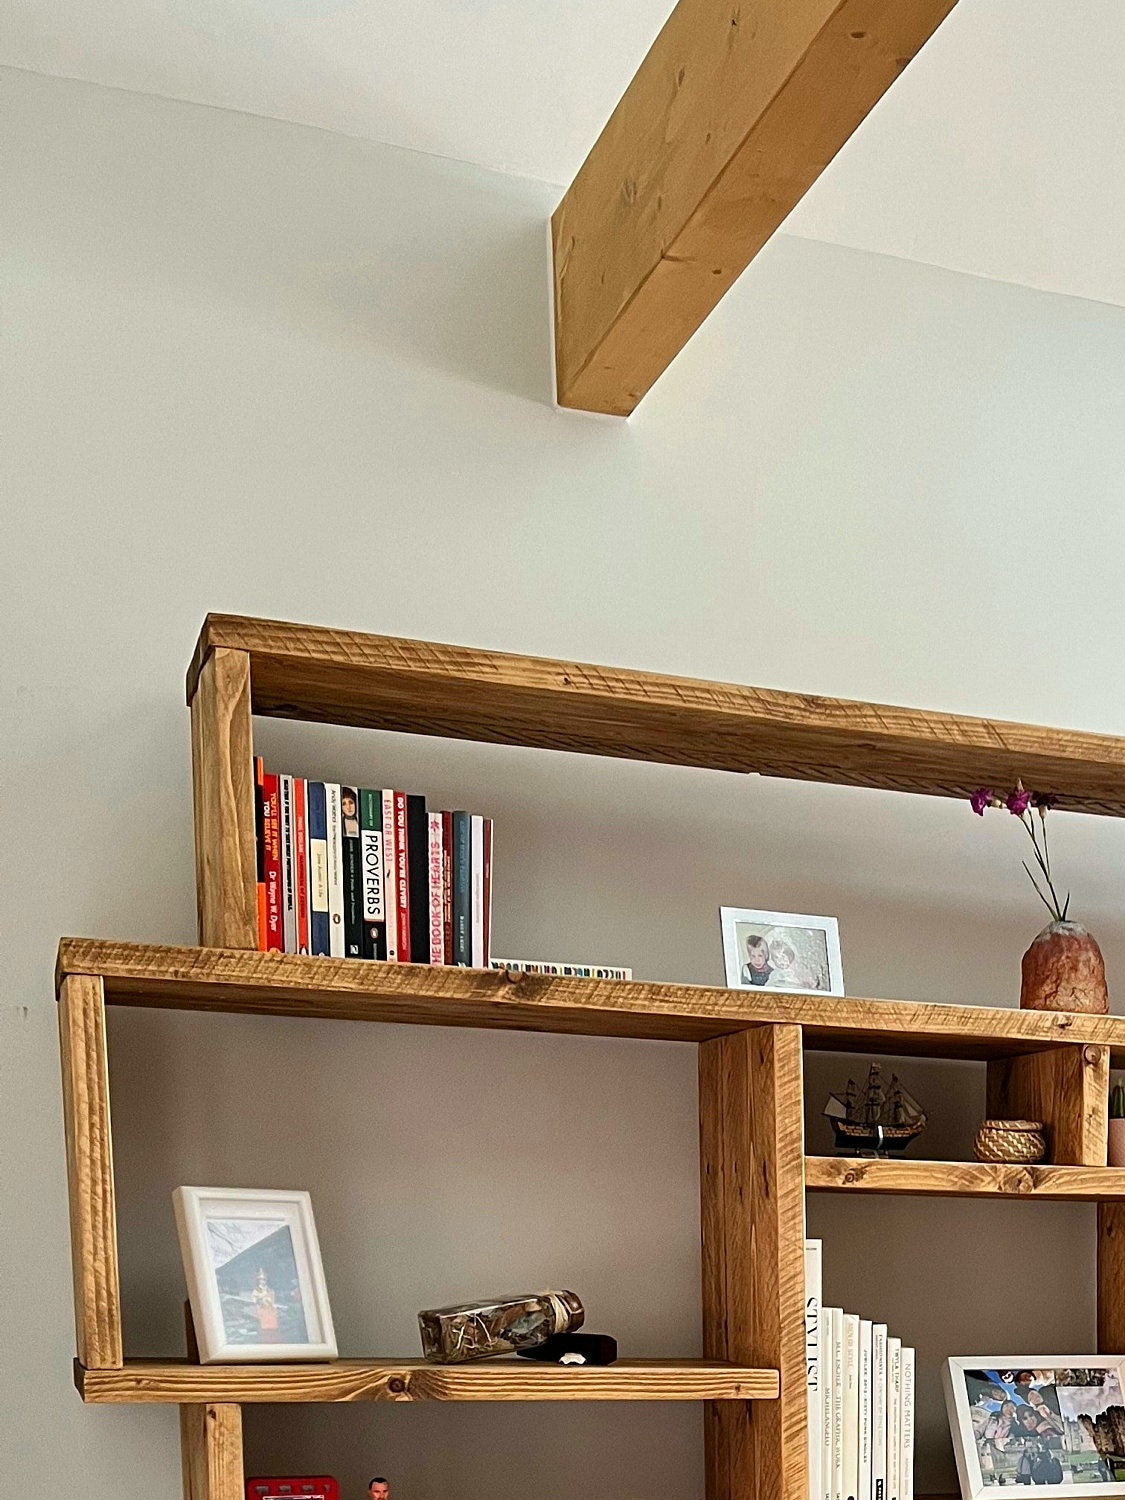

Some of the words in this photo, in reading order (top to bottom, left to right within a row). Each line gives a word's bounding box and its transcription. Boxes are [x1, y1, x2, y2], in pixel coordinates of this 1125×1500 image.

[397, 797, 404, 808] DO
[397, 811, 405, 827] YOU
[385, 824, 392, 836] OR
[269, 871, 277, 879] Dr
[365, 835, 380, 915] PROVERBS
[268, 882, 277, 904] Wayne
[431, 892, 441, 908] OF
[269, 915, 278, 932] Dyer
[431, 910, 441, 945] BOOK
[903, 1363, 912, 1407] NOTHING
[903, 1409, 912, 1448] MATTERS
